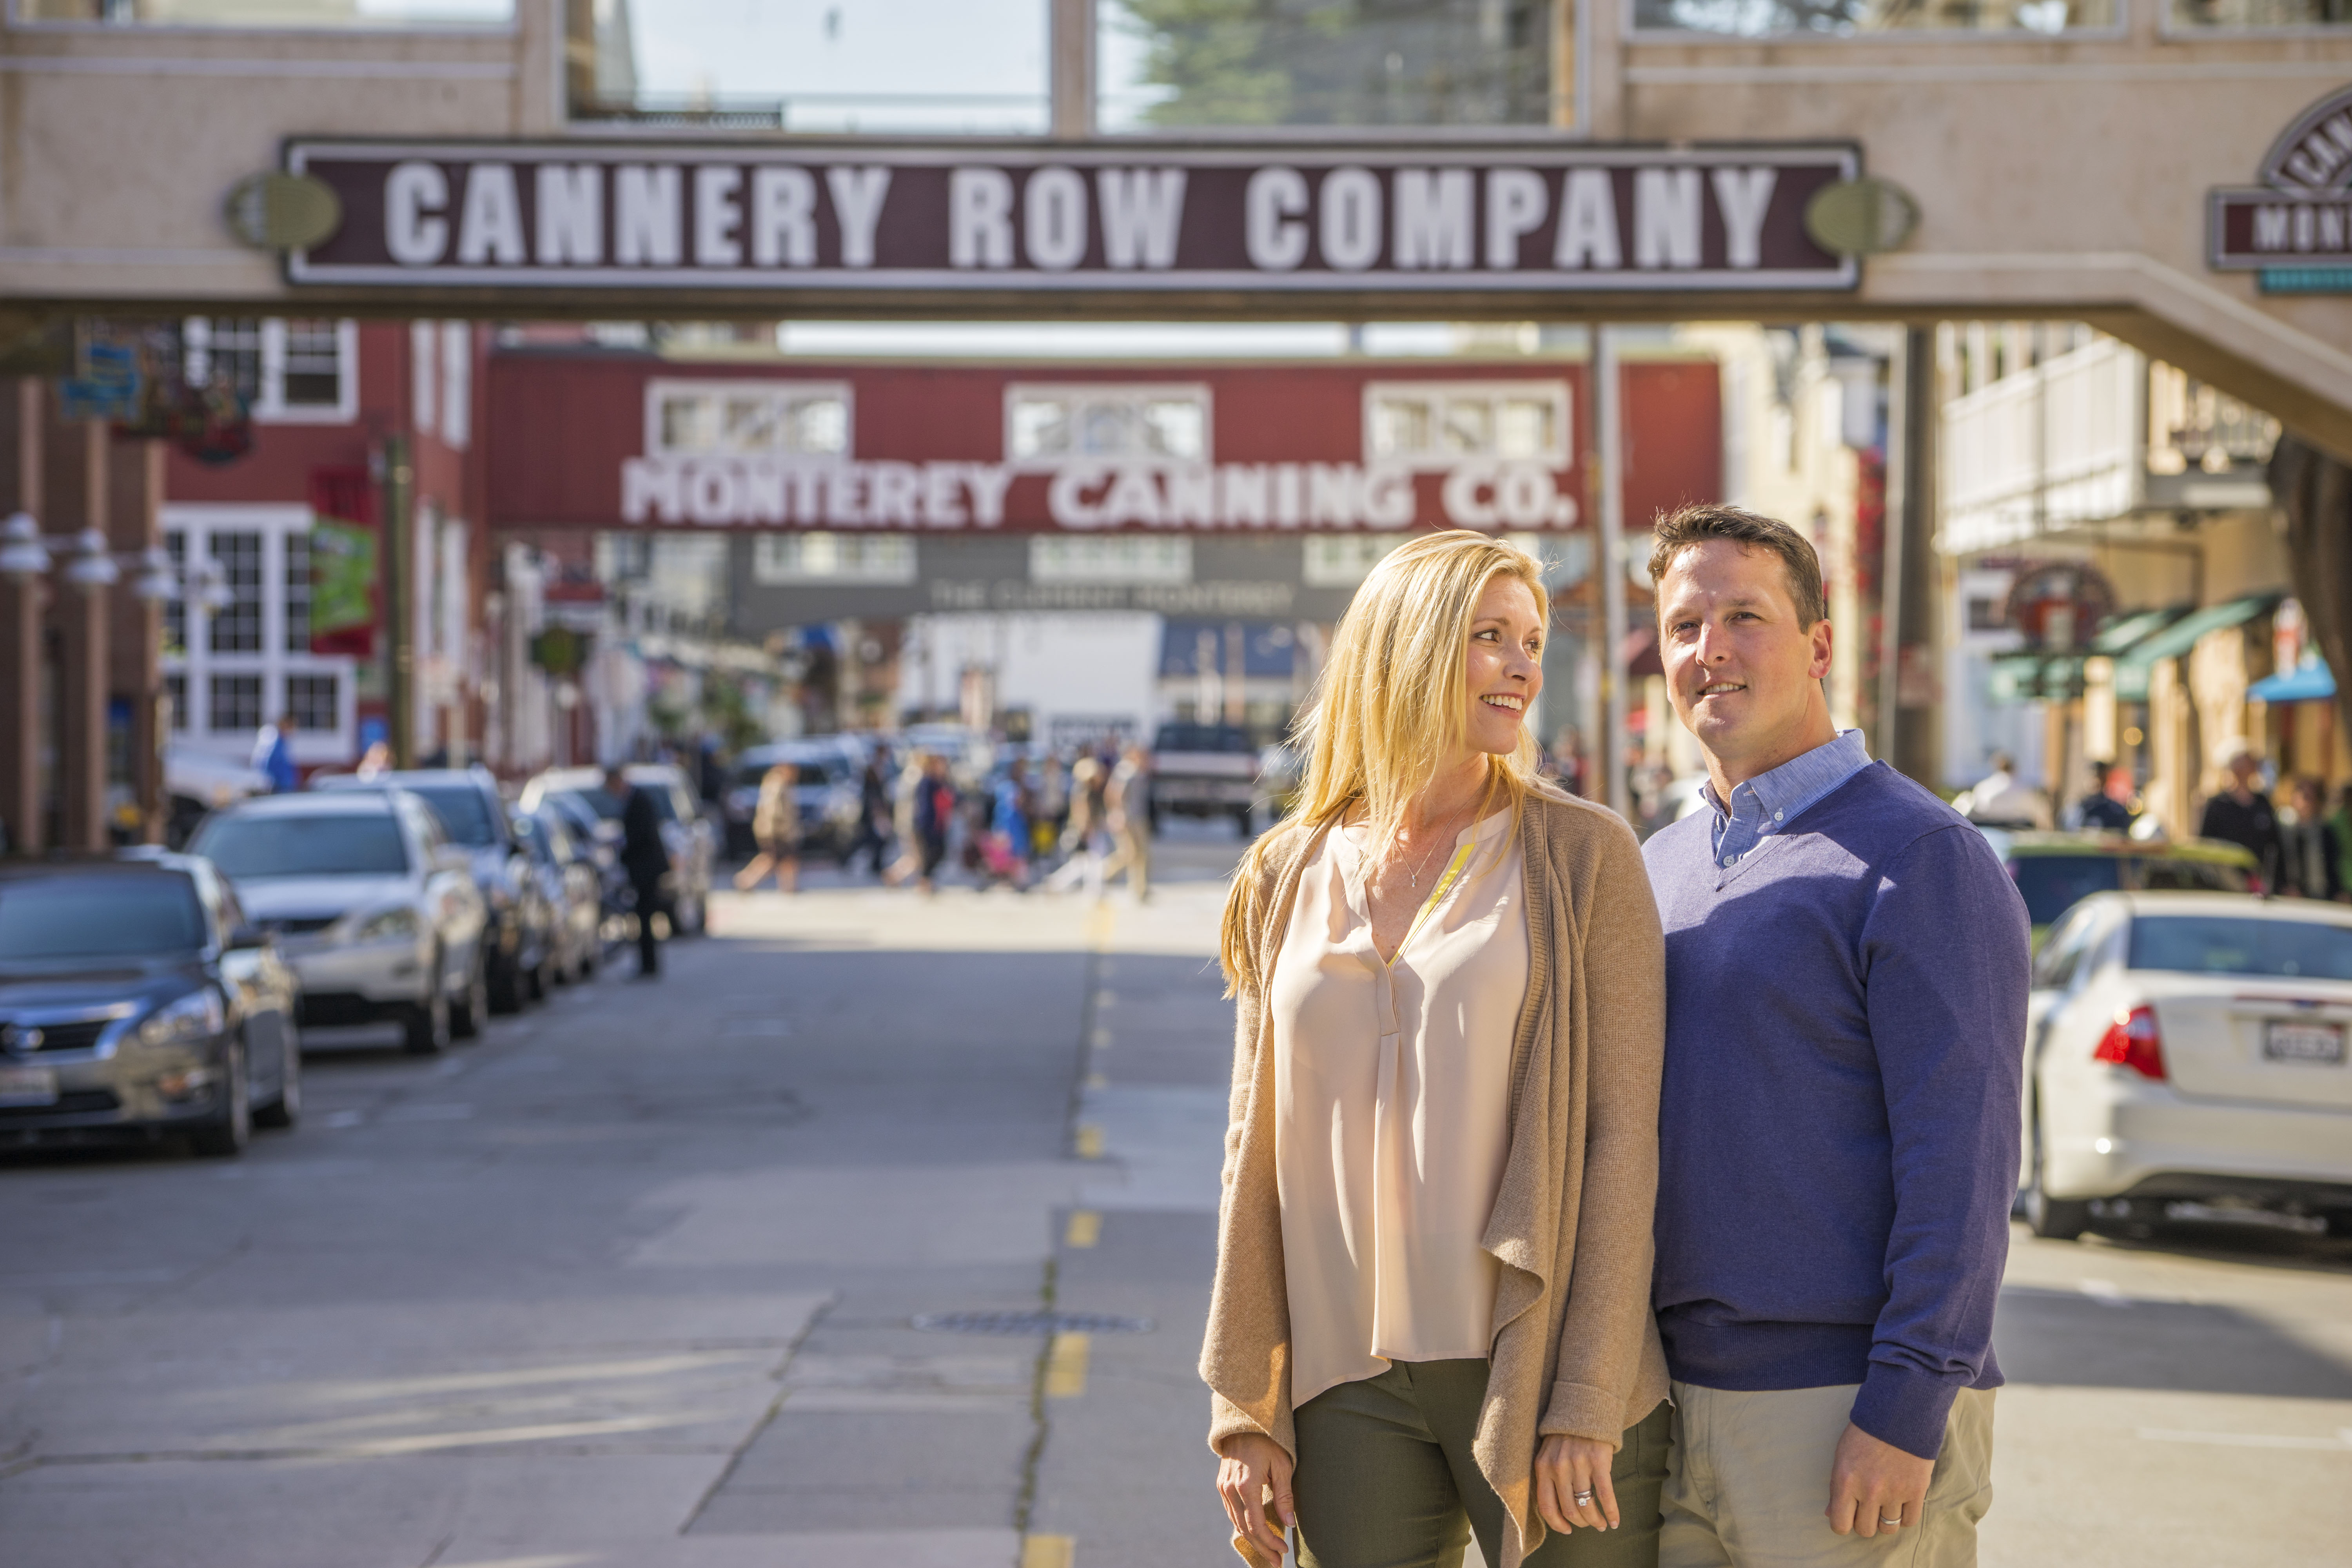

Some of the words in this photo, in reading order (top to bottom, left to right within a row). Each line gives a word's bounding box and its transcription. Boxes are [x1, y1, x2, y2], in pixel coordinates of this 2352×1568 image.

[384, 162, 892, 267] CANNERY
[949, 165, 1189, 270] ROW
[1243, 166, 1778, 270] COMPANY
[621, 458, 1020, 528] MONTEREY
[1047, 462, 1414, 529] CANNING
[1440, 465, 1578, 529] CO.
